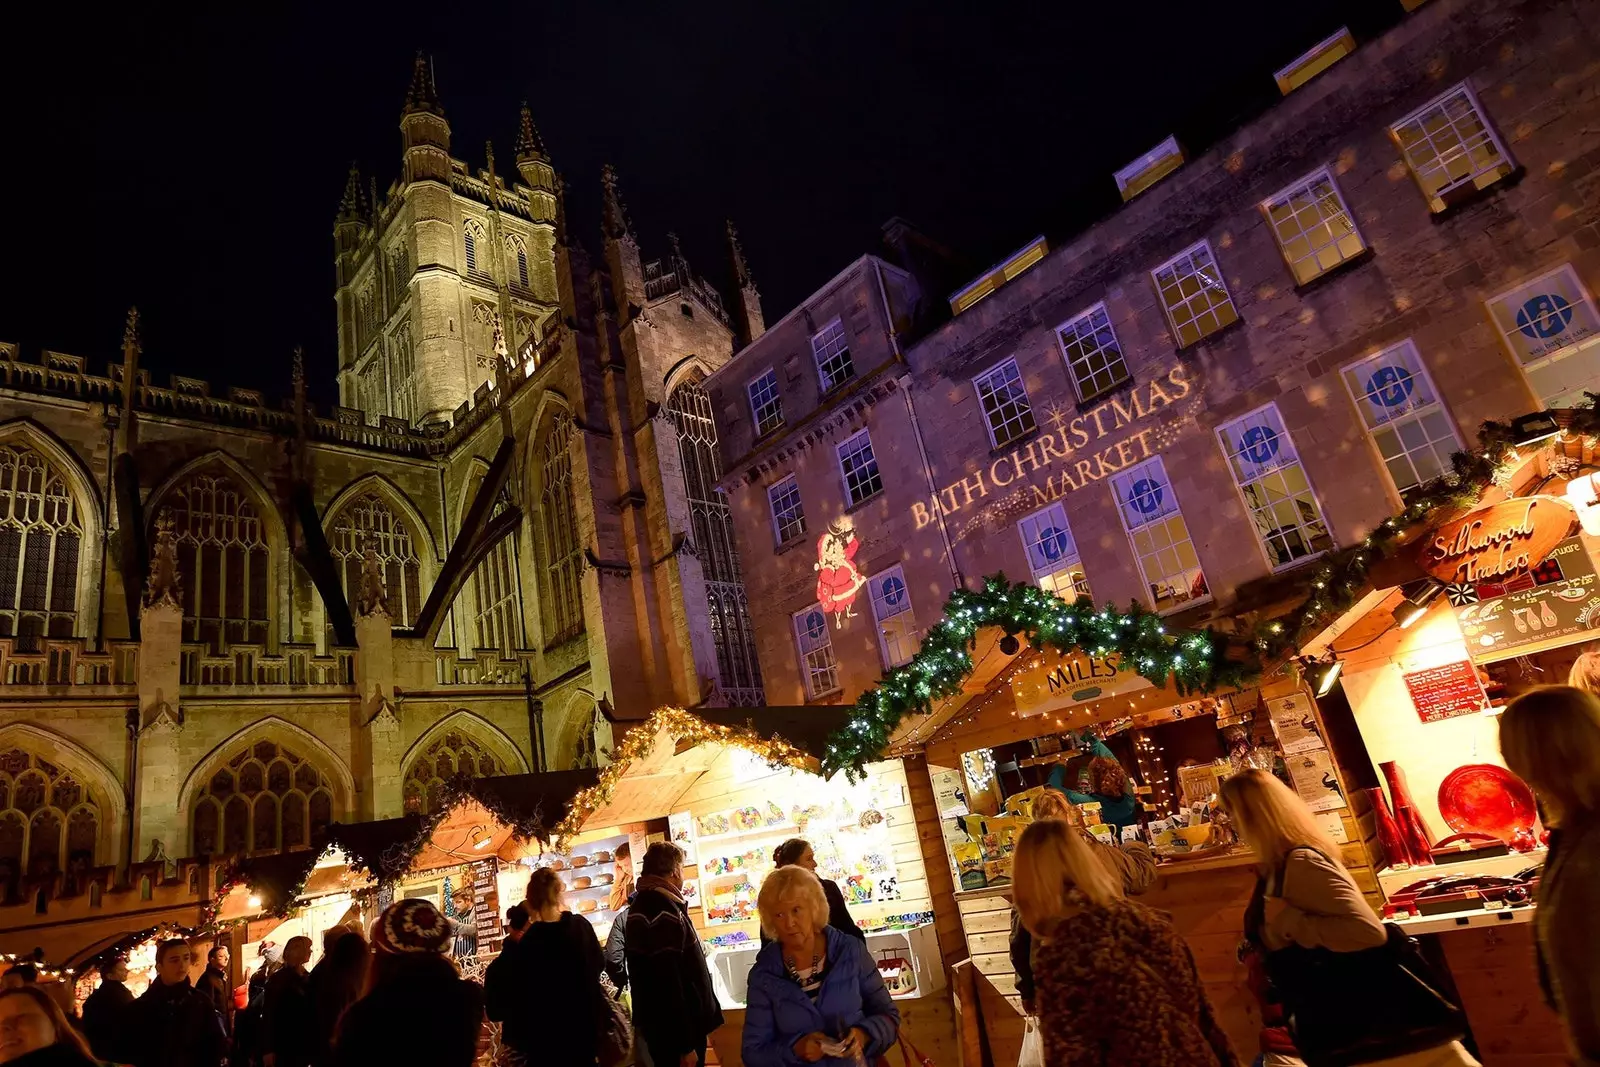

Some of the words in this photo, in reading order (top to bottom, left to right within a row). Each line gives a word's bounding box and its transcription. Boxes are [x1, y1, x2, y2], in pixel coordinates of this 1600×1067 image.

[910, 470, 988, 530] BATH
[990, 364, 1192, 486] CHRISTMAS
[1030, 427, 1156, 508] MARKET
[1434, 502, 1537, 561] Silkwood
[1457, 543, 1529, 583] Traders
[1047, 657, 1117, 693] MILES
[1189, 781, 1212, 795] WIN
